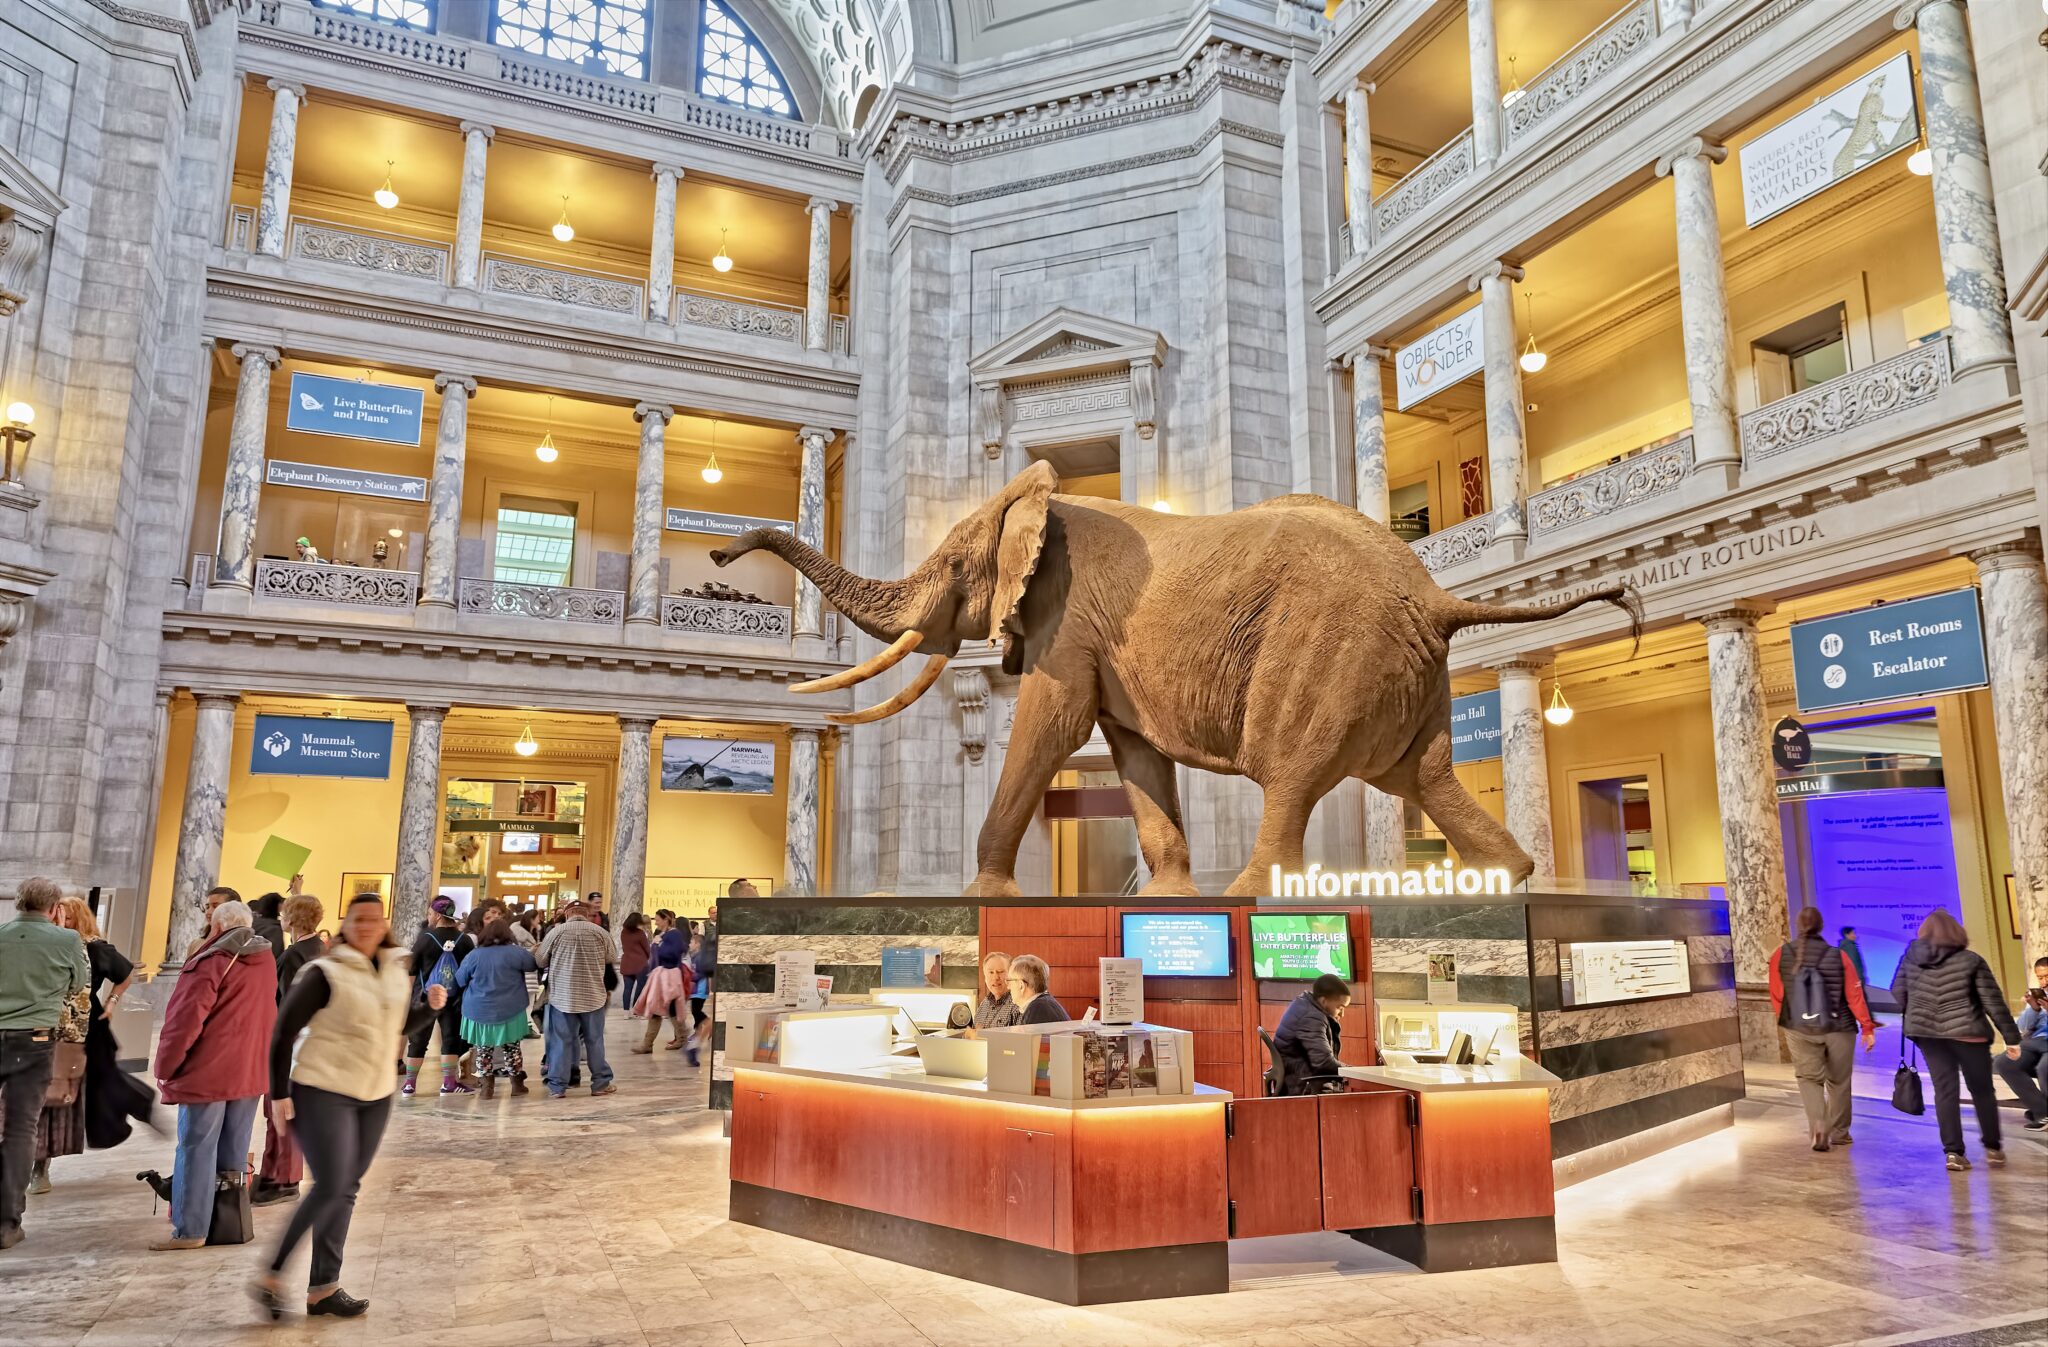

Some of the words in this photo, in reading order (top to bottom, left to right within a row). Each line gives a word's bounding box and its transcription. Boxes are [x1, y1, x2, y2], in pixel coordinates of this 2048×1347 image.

[1798, 124, 1823, 145] BEST
[1749, 136, 1825, 183] WINDLAND
[1750, 168, 1791, 198] SMITH
[1796, 148, 1824, 173] RICE
[1752, 161, 1828, 213] AWARDS
[1402, 324, 1463, 370] OBJECTS
[1405, 340, 1473, 389] WONDER
[333, 396, 357, 409] Live
[358, 399, 413, 416] Butterflies
[333, 410, 353, 420] and
[356, 410, 389, 424] Plants
[270, 467, 314, 483] Elephant
[316, 473, 363, 488] Discovery
[364, 477, 398, 492] Station
[668, 514, 704, 527] Elephant
[705, 518, 743, 534] Discovery
[1618, 556, 1692, 590] FAMILY
[1702, 519, 1825, 571] ROTUNDA
[1869, 629, 1903, 646] Rest
[1906, 618, 1963, 640] Rooms
[1872, 655, 1948, 678] Escalator
[1468, 705, 1486, 719] Hall
[302, 733, 355, 746] Mammals
[1451, 733, 1473, 744] uman
[1474, 727, 1502, 741] Origin
[300, 745, 348, 758] Museum
[350, 748, 381, 760] Store
[731, 746, 763, 754] NARWHAL
[1783, 744, 1802, 752] OCEAN
[1786, 751, 1801, 759] HALL
[1776, 783, 1799, 794] CEAN
[1799, 780, 1829, 791] HALL
[499, 822, 535, 831] MAMMALS
[1270, 858, 1511, 897] Information
[653, 888, 684, 896] KENNETH
[649, 897, 677, 908] HALL
[678, 899, 693, 908] OF
[1253, 932, 1276, 942] LIVE
[1277, 932, 1346, 943] BUTTERFLIES
